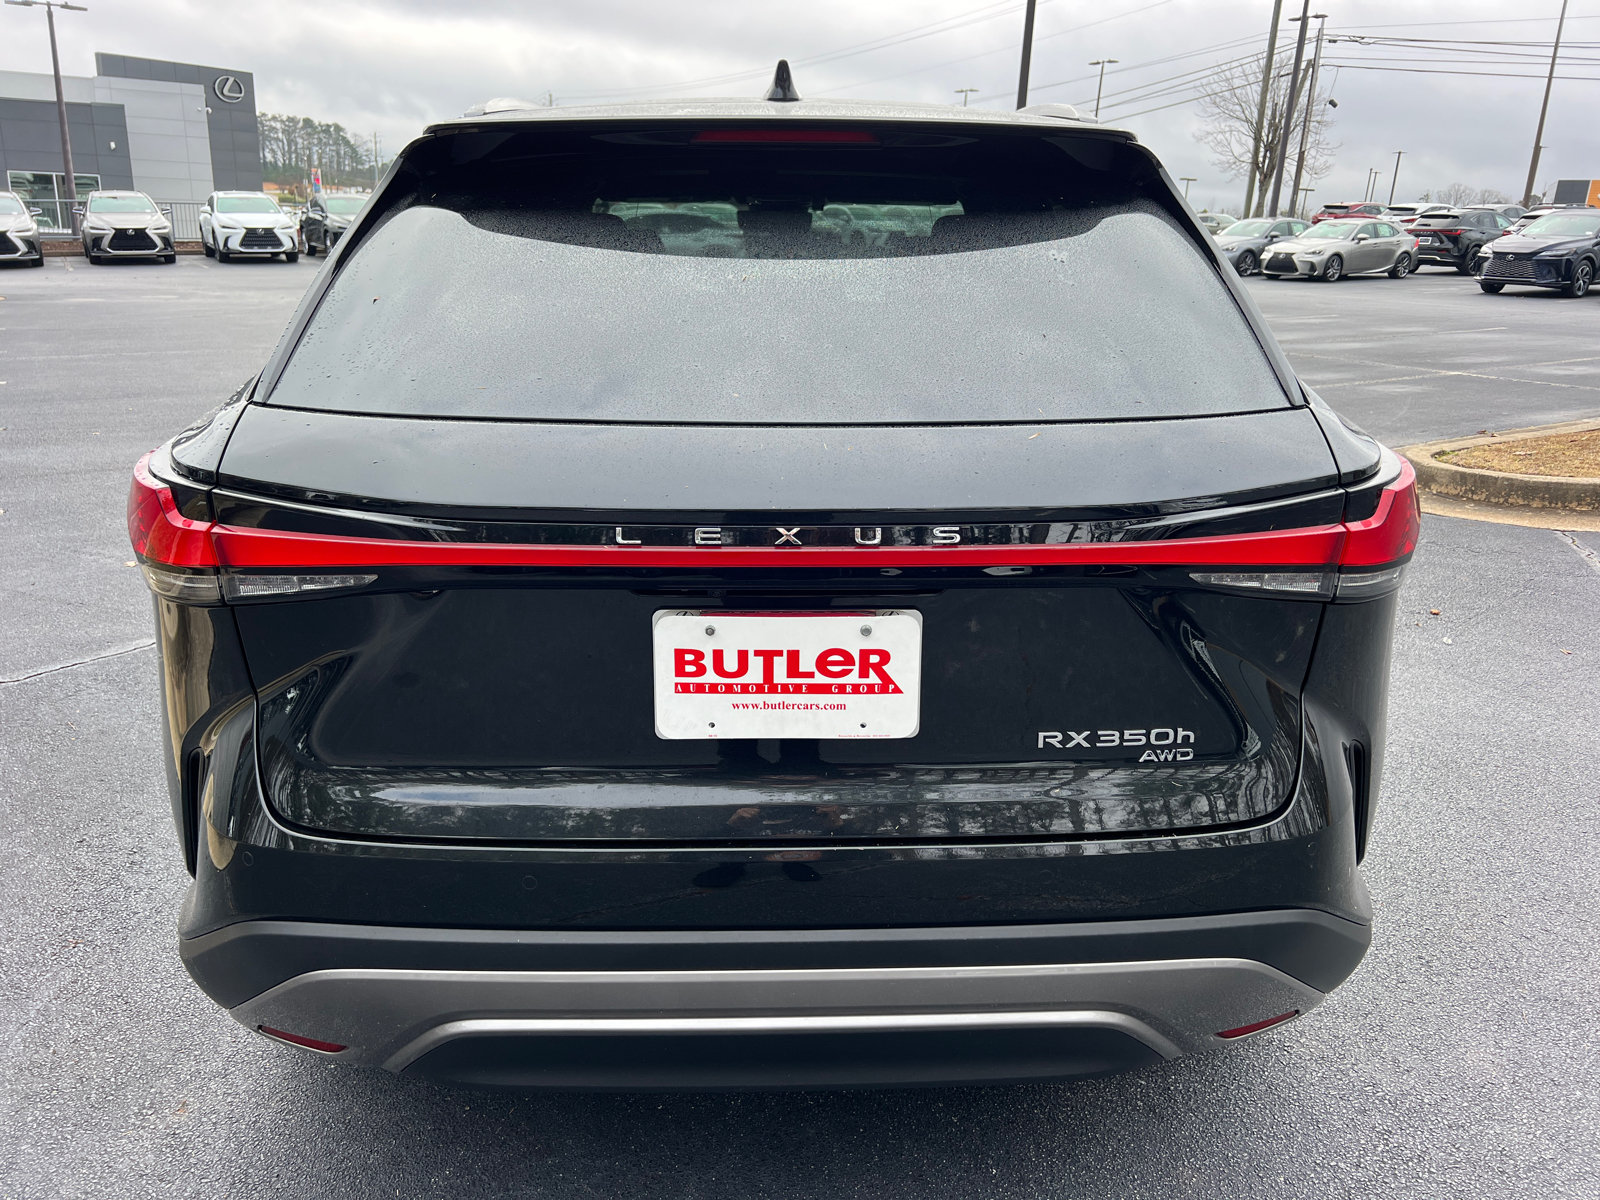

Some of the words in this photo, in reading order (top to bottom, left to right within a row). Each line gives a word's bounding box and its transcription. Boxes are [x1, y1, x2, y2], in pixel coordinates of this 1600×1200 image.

[615, 527, 961, 545] LEXUS
[676, 684, 808, 693] AUTOMOTIVE
[832, 684, 895, 693] GROUP
[731, 701, 847, 711] www.butlercars.com
[1138, 748, 1194, 763] AWD
